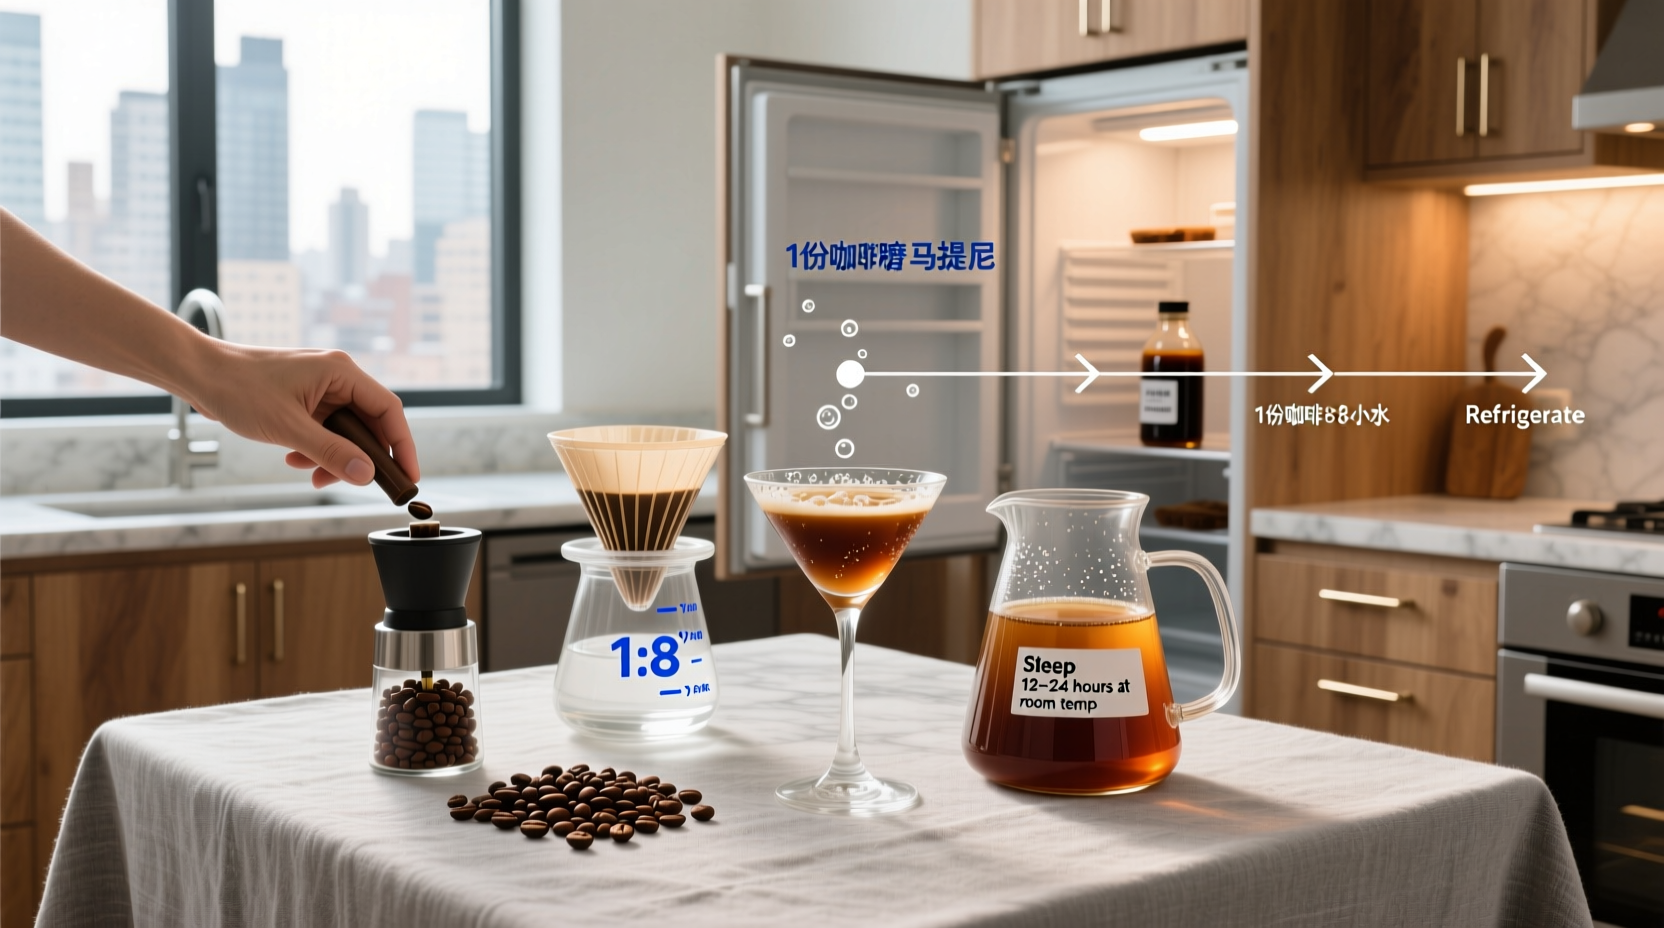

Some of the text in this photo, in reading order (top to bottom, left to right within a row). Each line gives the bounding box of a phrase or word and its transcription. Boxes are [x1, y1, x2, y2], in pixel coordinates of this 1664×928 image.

[611, 635, 680, 678] 1:8
[1073, 679, 1114, 693] hours
[1118, 679, 1131, 693] at
[1019, 698, 1097, 714] room temp
